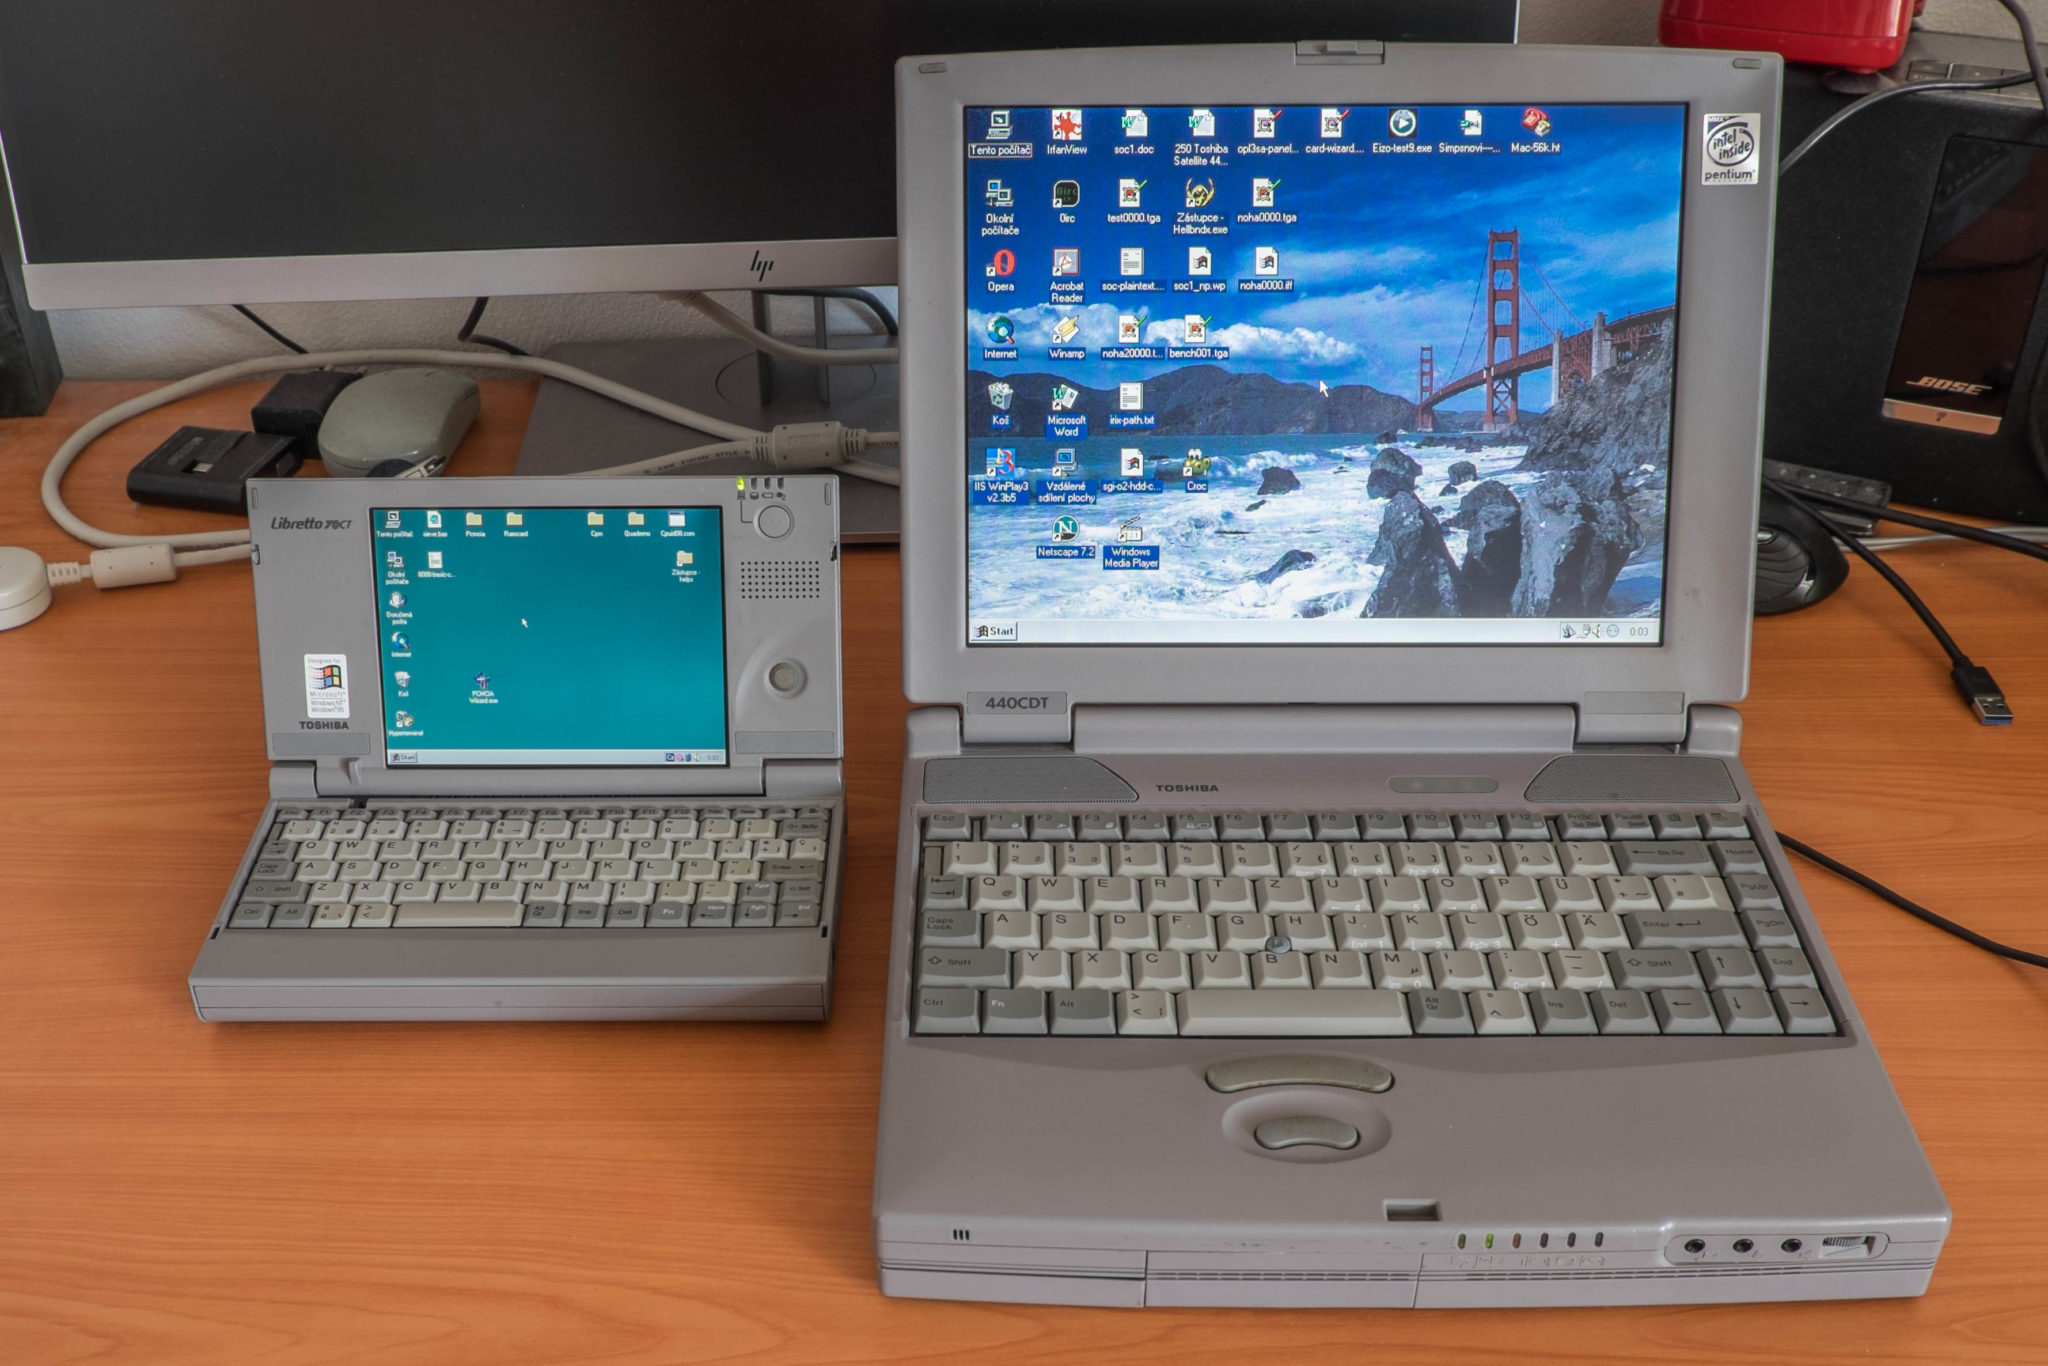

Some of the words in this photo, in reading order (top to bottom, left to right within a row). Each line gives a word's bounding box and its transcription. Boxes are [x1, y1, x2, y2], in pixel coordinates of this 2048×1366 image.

[1714, 129, 1736, 149] intel
[971, 145, 995, 155] Tento
[998, 144, 1030, 155] počítač
[1047, 144, 1087, 154] IrfanView
[1114, 144, 1154, 153] soc1.doc
[1175, 144, 1192, 153] 250
[1195, 144, 1228, 153] Toshiba
[1372, 143, 1432, 153] Eizo-test9.exe
[1511, 143, 1560, 153] Mac-56k.ht
[1719, 141, 1750, 159] inside
[1174, 156, 1207, 165] Satellite
[1705, 169, 1752, 181] pentium
[986, 213, 1013, 223] Okolní
[1108, 213, 1161, 224] test0000.tga
[1177, 213, 1218, 223] Zástupce
[1238, 213, 1297, 223] noha0000.tga
[982, 225, 1019, 236] počítače
[750, 250, 774, 282] hp
[988, 282, 1014, 292] Opera
[1050, 282, 1084, 290] Acrobat
[1240, 281, 1292, 290] noha0000.iff
[1052, 294, 1083, 303] Reader
[984, 349, 1017, 358] Internet
[1049, 349, 1084, 359] Winamp
[1170, 349, 1228, 359] bench001.tga
[1906, 376, 1992, 395] BOSE
[993, 415, 1009, 425] Koš
[1048, 415, 1086, 425] Microsoft
[1110, 415, 1155, 426] irix-path.txt
[1054, 427, 1078, 436] Word
[989, 481, 1028, 492] WinPlay3
[1047, 481, 1085, 491] Vzdálené
[1187, 482, 1206, 491] Croc
[987, 494, 1016, 502] v2.3b5
[1038, 493, 1065, 502] sdílení
[1068, 493, 1096, 504] plochy
[271, 517, 323, 530] Libretto
[1038, 547, 1078, 557] Netscape
[1080, 547, 1094, 556] 7.2
[1111, 547, 1150, 556] Windows
[1105, 559, 1129, 568] Media
[1130, 559, 1158, 569] Player
[991, 627, 1013, 635] Start
[985, 697, 1049, 709] 440CDT
[299, 721, 349, 729] TOSHIBA
[983, 878, 995, 887] Q
[1041, 878, 1057, 886] W
[1098, 879, 1108, 887] E
[1155, 879, 1166, 887] R
[1270, 880, 1280, 888] Z
[1327, 879, 1338, 888] U
[1441, 879, 1454, 887] O
[1500, 879, 1509, 887] P
[1556, 879, 1568, 890] Ü
[997, 914, 1008, 922] A
[1056, 914, 1067, 923] S
[1114, 916, 1125, 924] D
[1173, 916, 1182, 924] F
[1231, 916, 1244, 925] G
[1289, 916, 1301, 925] H
[1348, 916, 1356, 924] J
[1406, 916, 1419, 924] K
[1465, 916, 1476, 924] L
[1524, 914, 1538, 927] Ö
[1582, 914, 1597, 927] Ä
[1028, 952, 1039, 961] Y
[1087, 953, 1098, 962] X
[1146, 953, 1158, 963] C
[1207, 954, 1218, 963] V
[1266, 954, 1278, 963] B
[1325, 954, 1337, 963] N
[1385, 954, 1399, 962] M
